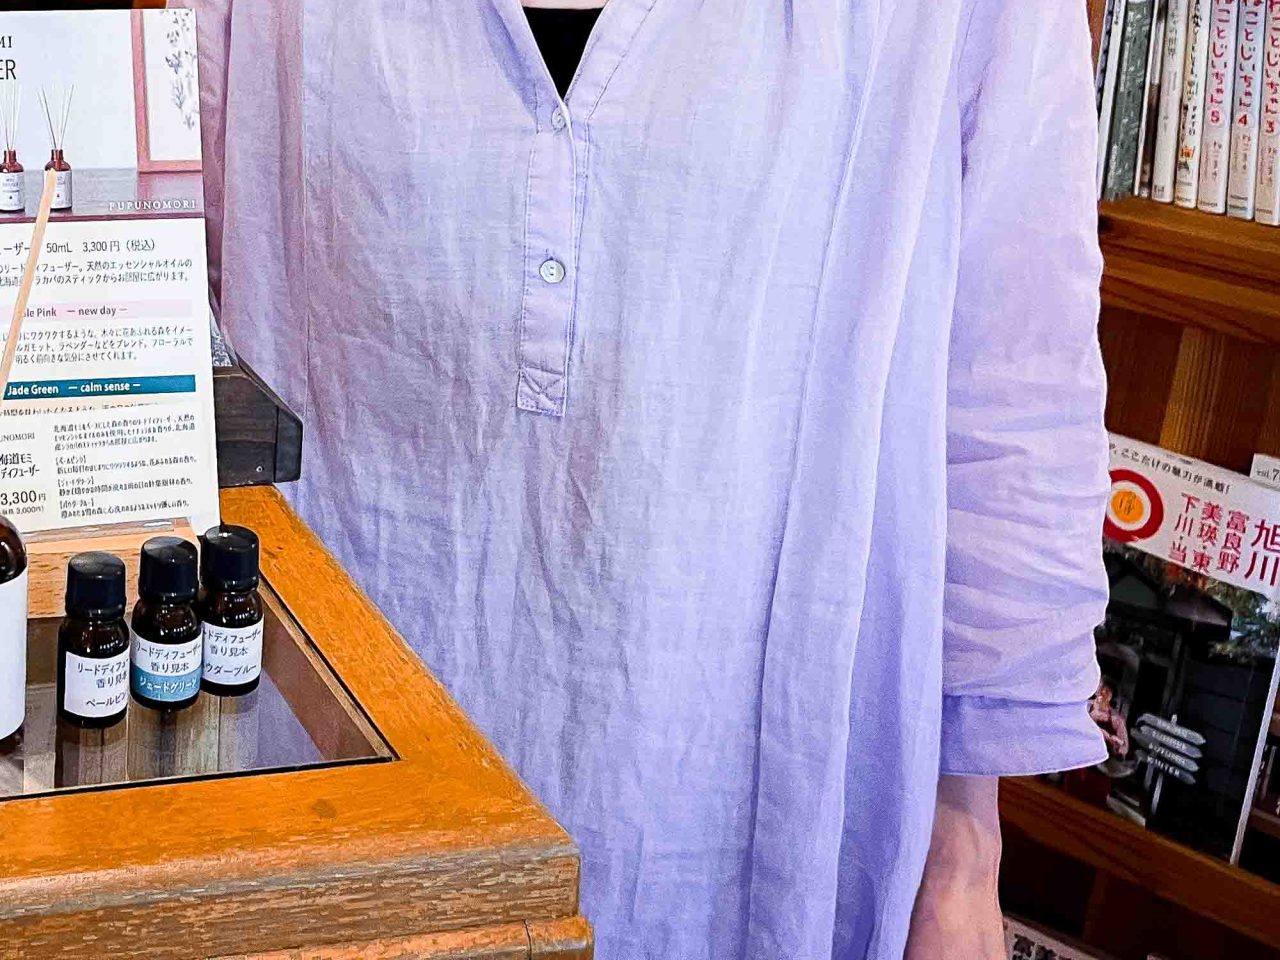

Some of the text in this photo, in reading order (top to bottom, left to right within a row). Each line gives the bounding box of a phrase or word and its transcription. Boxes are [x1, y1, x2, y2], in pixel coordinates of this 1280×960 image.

[1210, 111, 1220, 124] 5
[1238, 114, 1248, 126] 4
[46, 242, 72, 253] 50mL
[36, 305, 117, 318] Pink new day
[8, 382, 130, 396] Jade Green calm sense
[1217, 510, 1250, 574] 富良野
[210, 644, 248, 657] 香り見本
[150, 661, 190, 673] 香り見本
[205, 663, 257, 676] ウダーブルー
